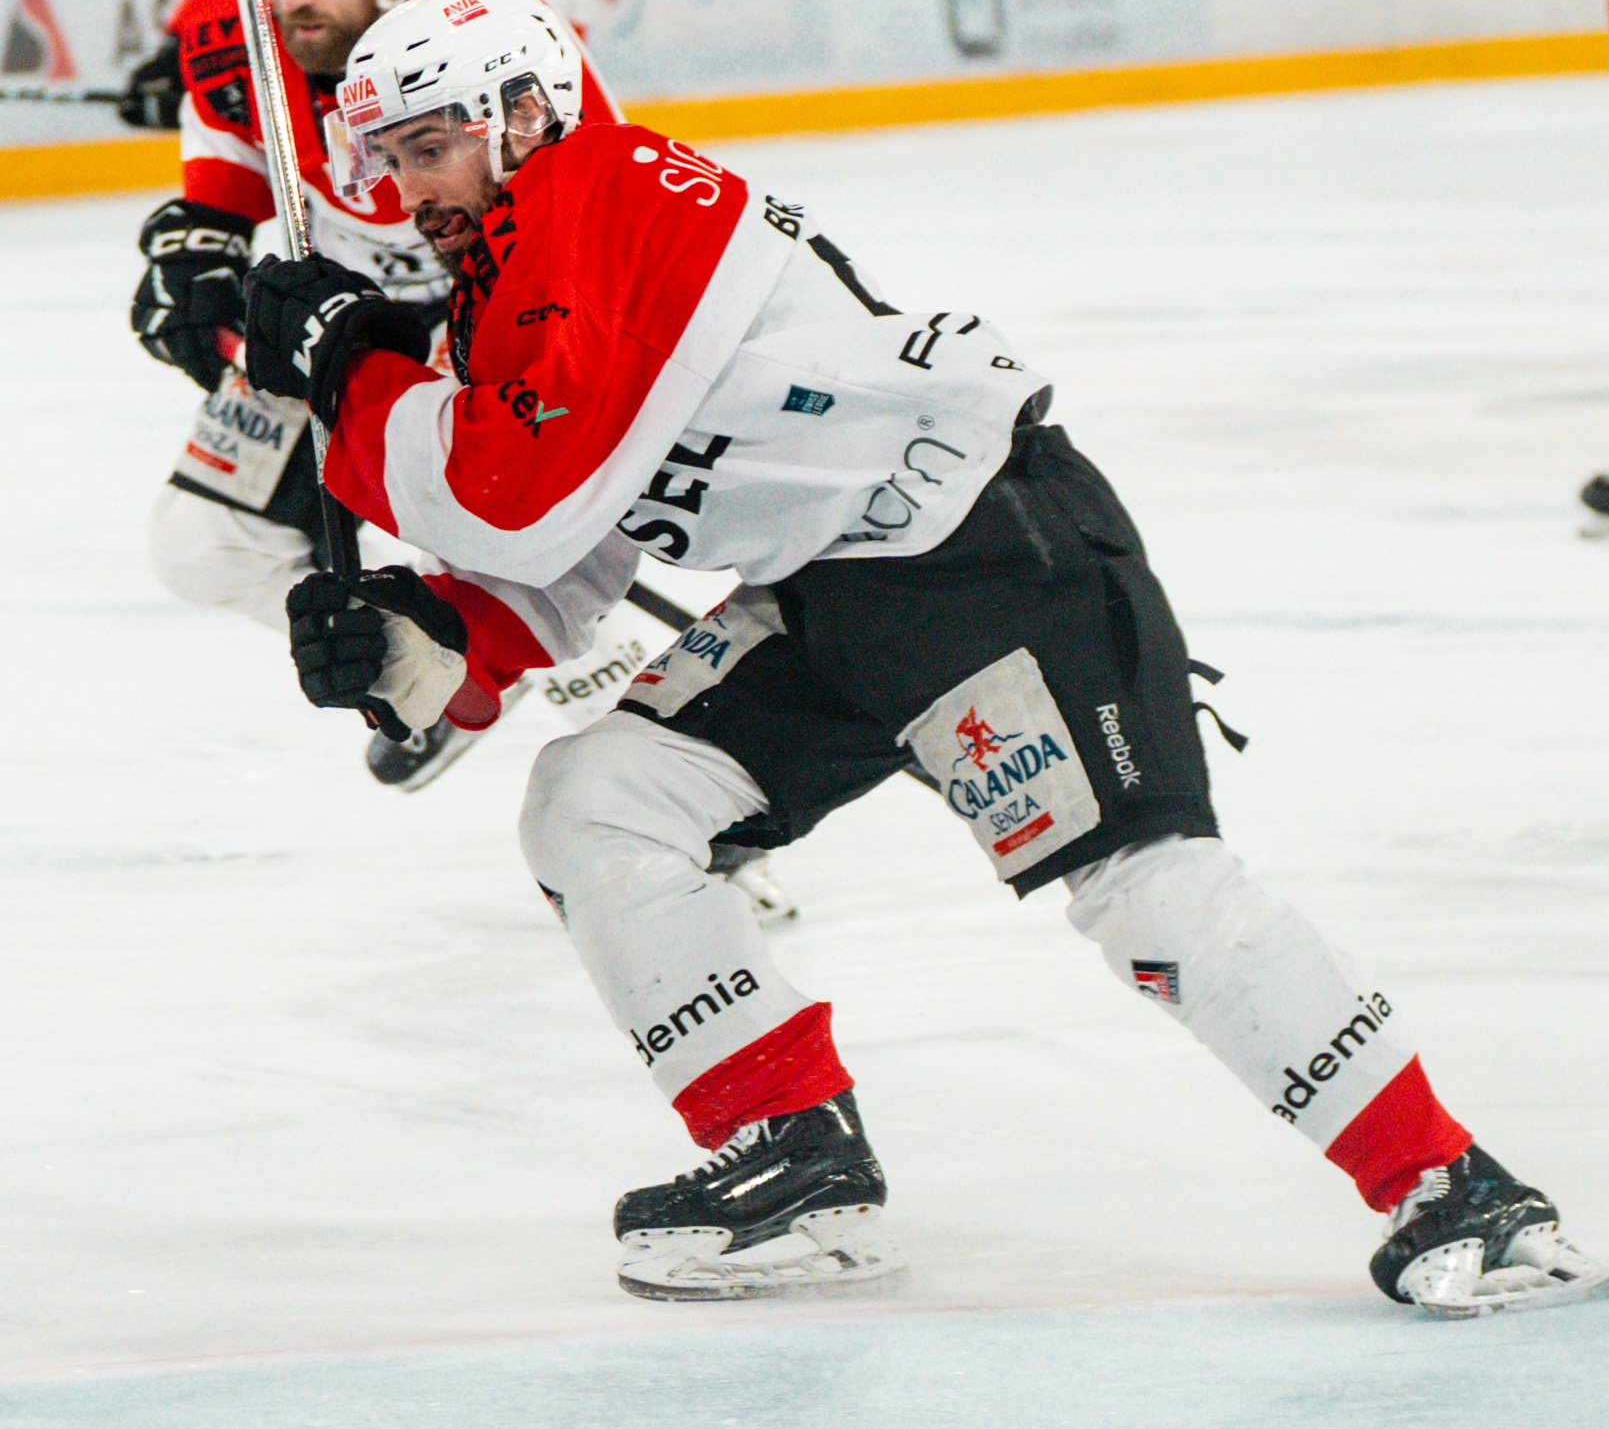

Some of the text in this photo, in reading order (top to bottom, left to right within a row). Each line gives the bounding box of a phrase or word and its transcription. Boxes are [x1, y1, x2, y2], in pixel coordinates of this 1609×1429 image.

[947, 732, 1069, 822] CALANDA
[1095, 702, 1142, 790] Reebok
[989, 794, 1042, 836] SENZA
